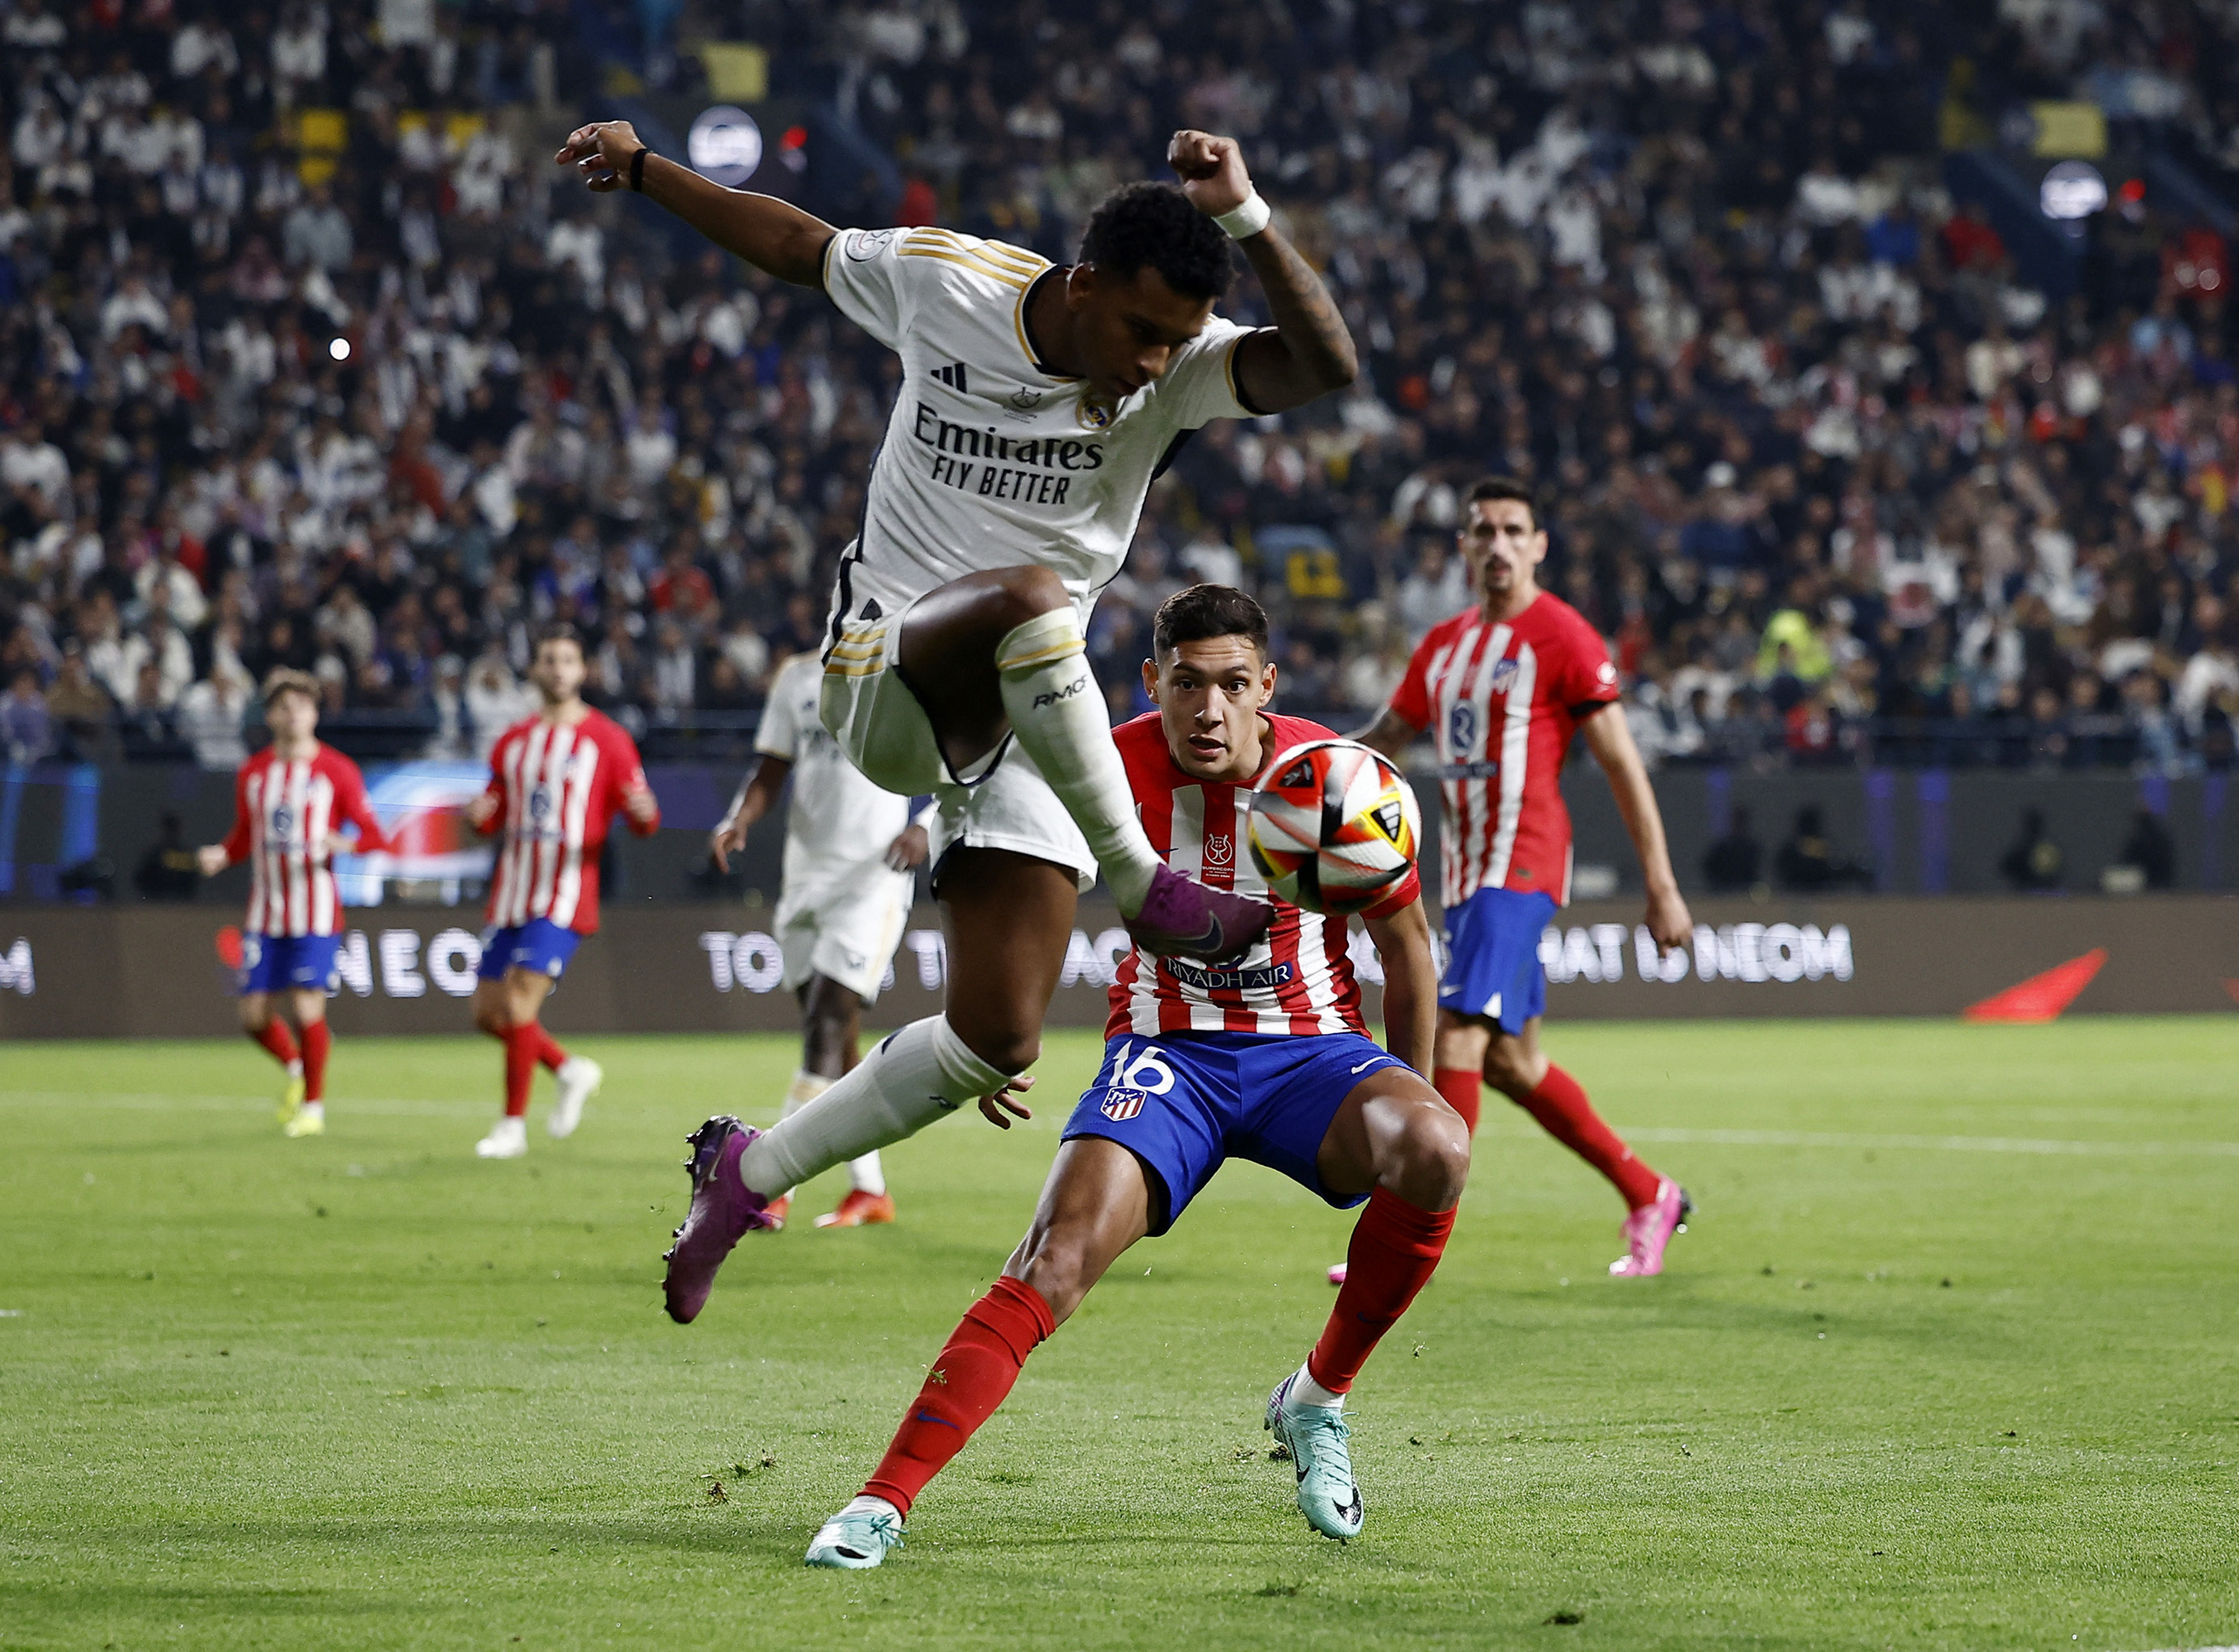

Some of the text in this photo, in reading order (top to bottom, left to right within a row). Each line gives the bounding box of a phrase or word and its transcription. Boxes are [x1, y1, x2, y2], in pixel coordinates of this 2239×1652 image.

[914, 401, 1104, 471] Emirates
[931, 455, 1071, 505] FLY BETTER
[325, 928, 557, 997] NEO
[1168, 957, 1291, 989] RIYADH AIR
[1108, 1038, 1176, 1096] 16
